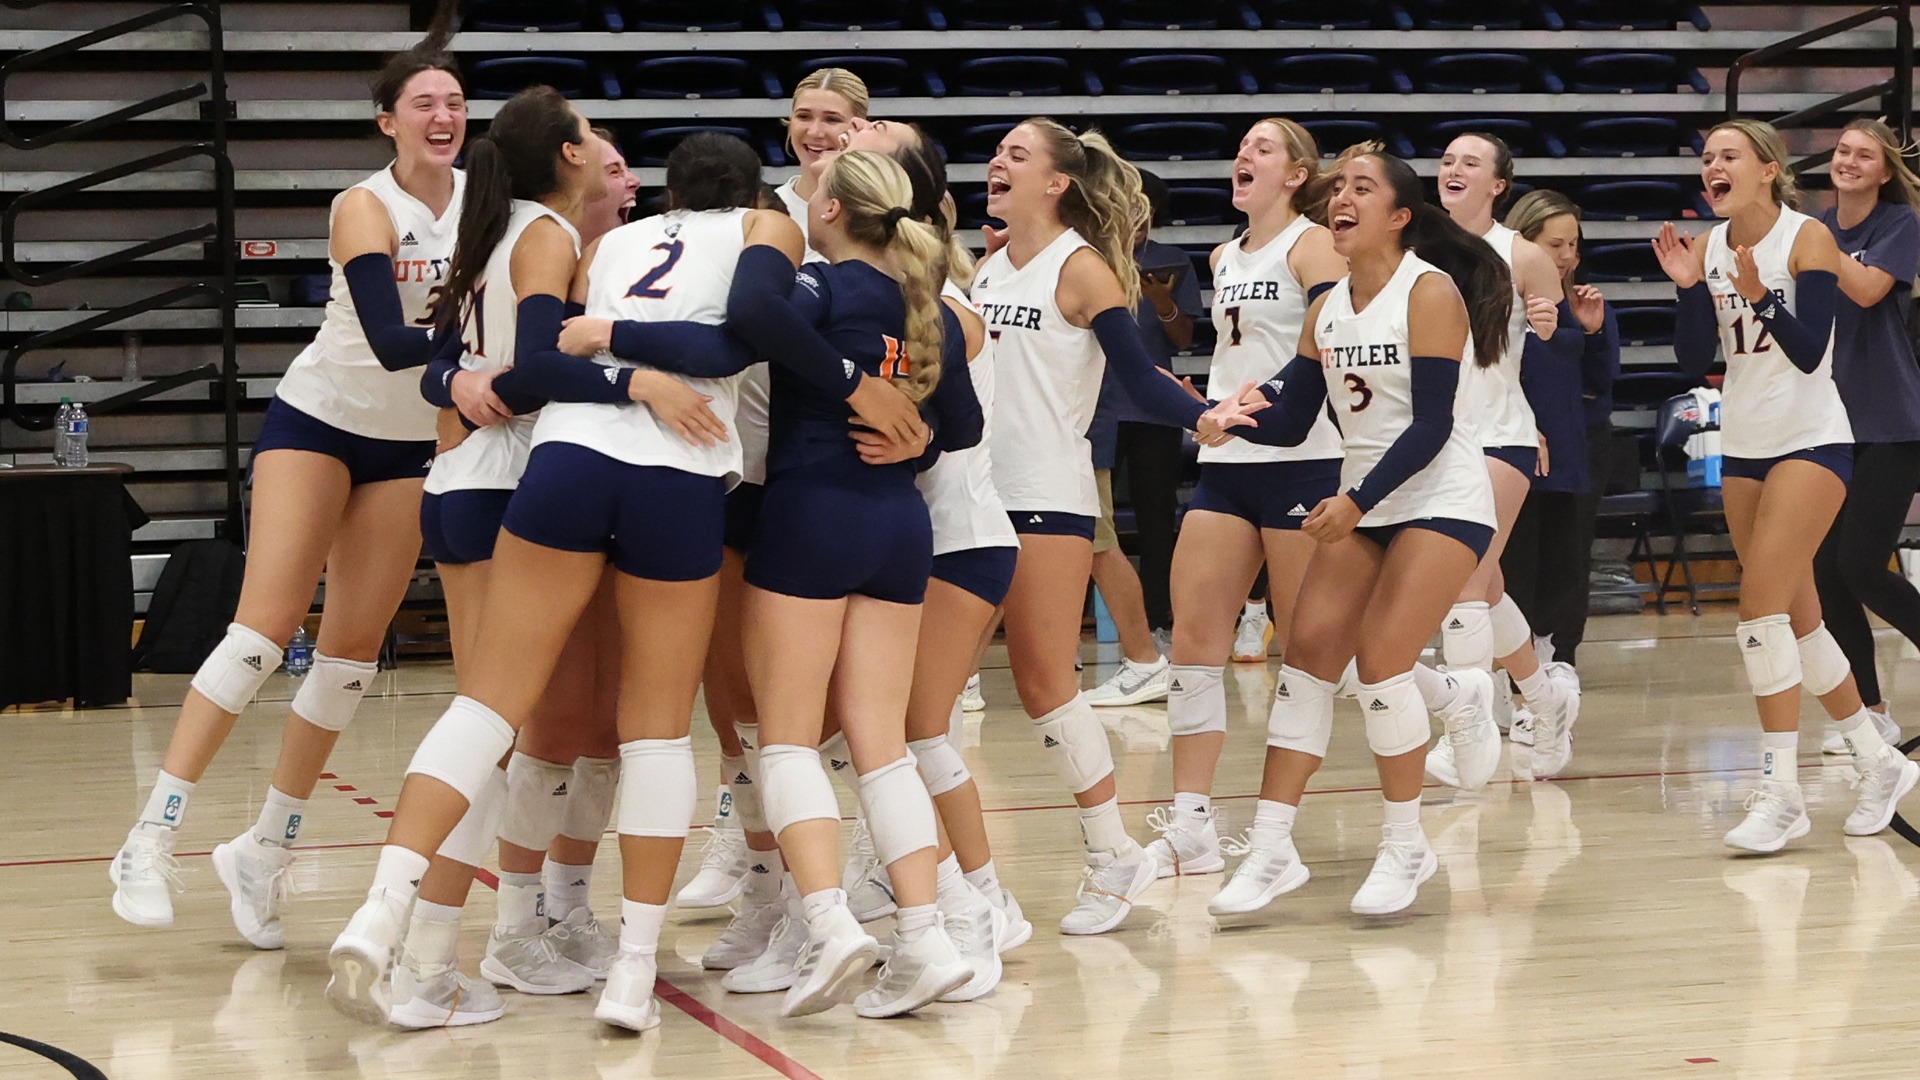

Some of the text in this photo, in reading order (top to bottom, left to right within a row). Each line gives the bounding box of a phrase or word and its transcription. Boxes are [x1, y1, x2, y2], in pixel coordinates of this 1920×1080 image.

[623, 239, 685, 300] 2
[1219, 281, 1280, 304] TYLER
[982, 303, 1042, 331] TYLER
[1729, 313, 1772, 355] 12
[1333, 343, 1401, 368] TYLER
[1343, 372, 1373, 413] 3
